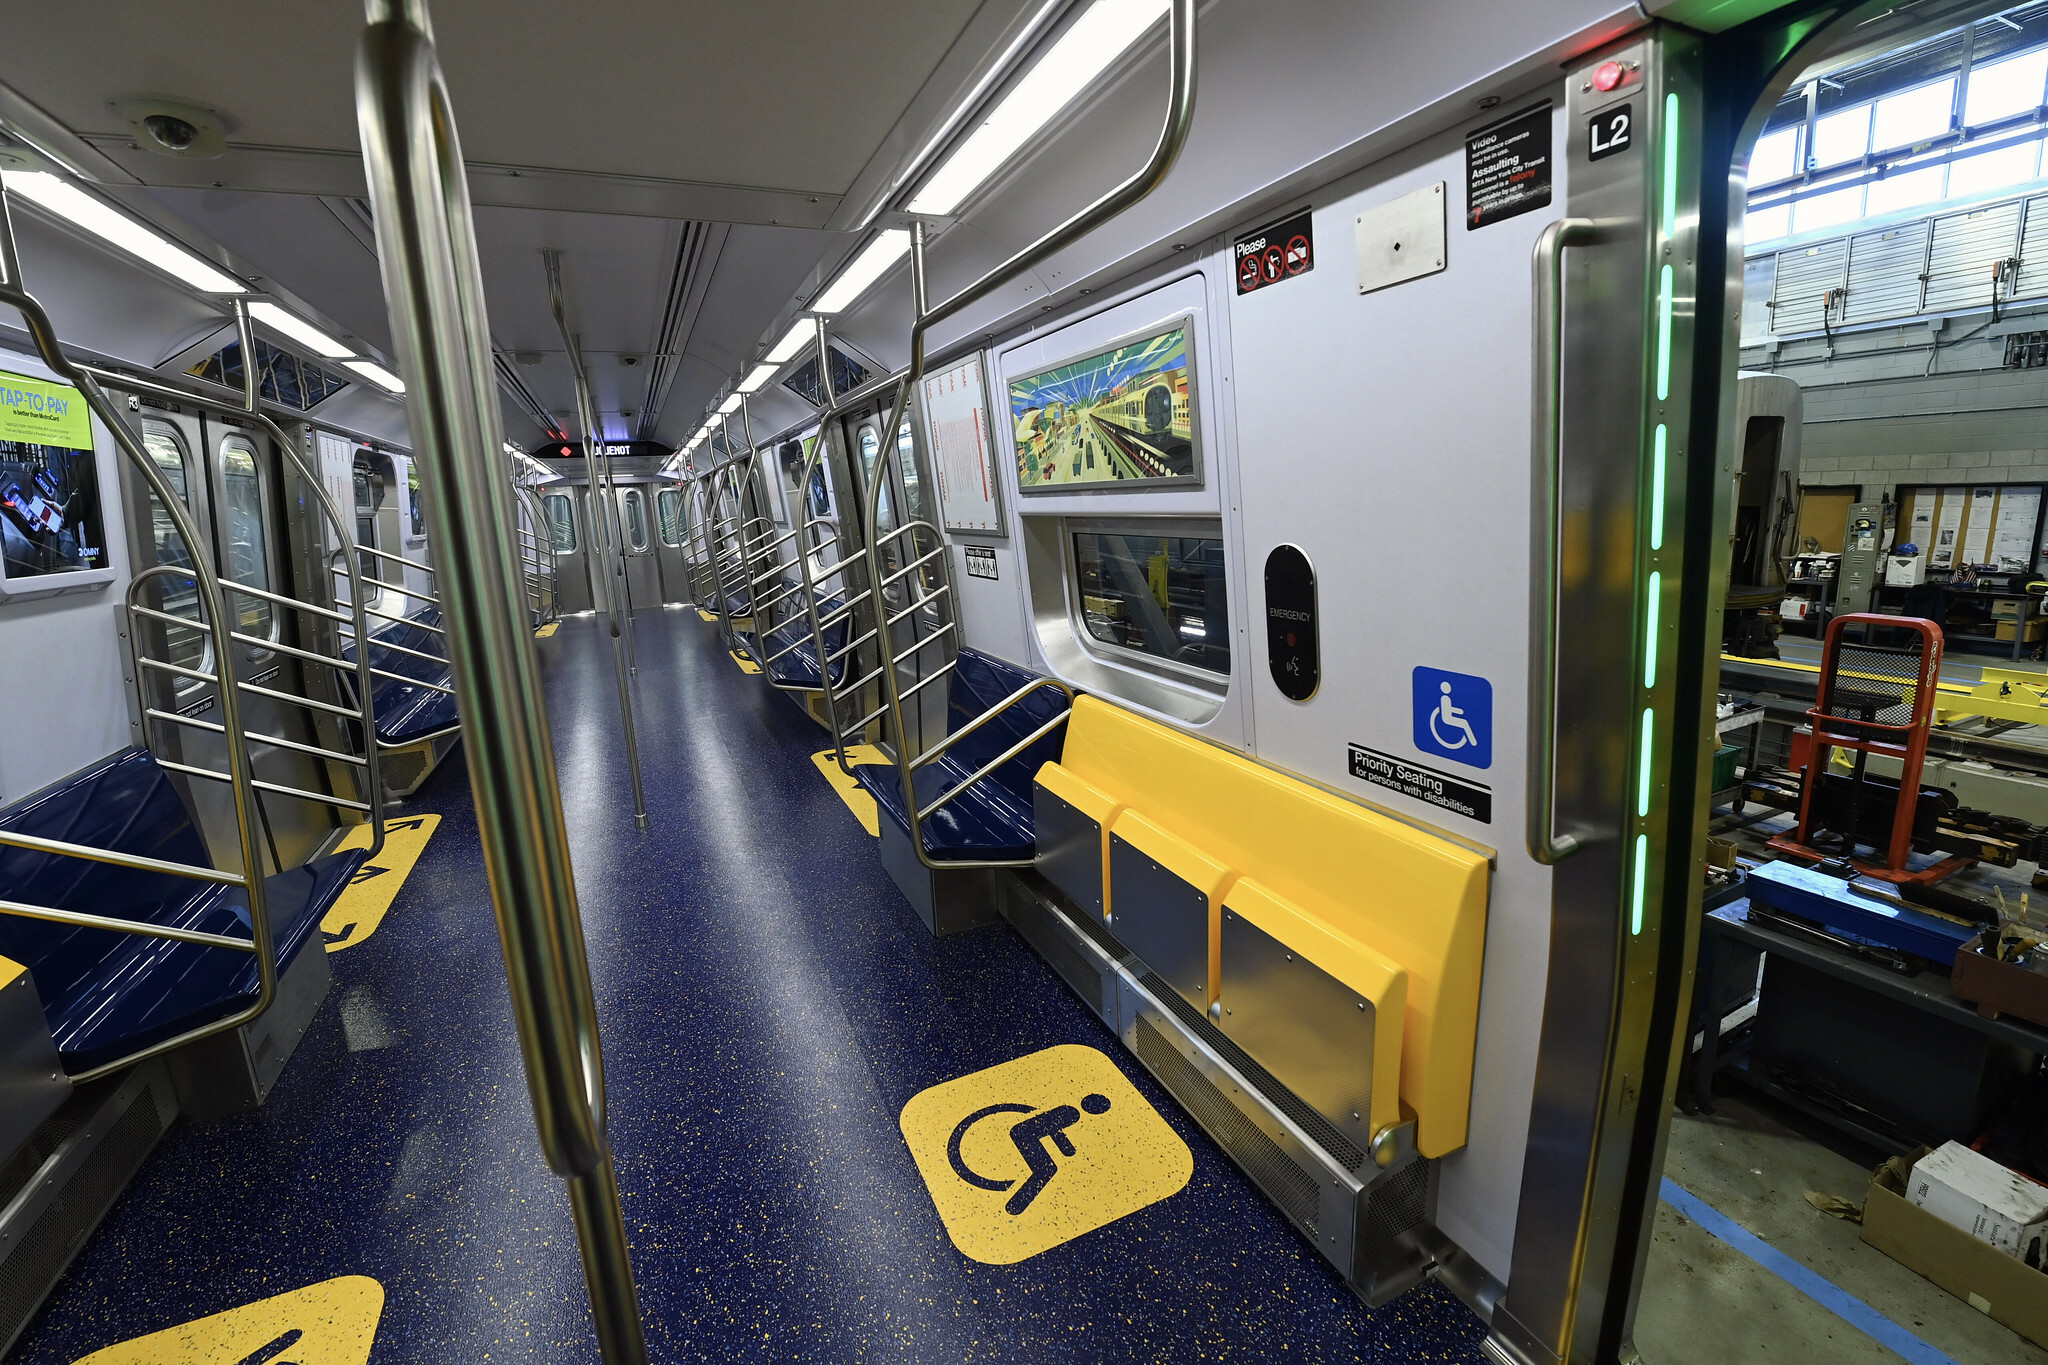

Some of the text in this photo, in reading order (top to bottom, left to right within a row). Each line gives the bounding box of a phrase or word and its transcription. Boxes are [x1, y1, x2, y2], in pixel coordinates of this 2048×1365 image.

[1472, 135, 1497, 150] Video
[1472, 131, 1530, 159] surveillance cameras
[1591, 114, 1629, 154] L2
[1472, 158, 1483, 167] may
[1472, 155, 1519, 179] Assaulting
[1472, 156, 1545, 189] MTA New York City Transit
[1472, 183, 1498, 198] personnel
[1509, 169, 1536, 183] felony
[1473, 206, 1482, 223] 7
[1237, 238, 1266, 258] Please
[0, 387, 68, 416] TAP-TO-PAY
[83, 547, 99, 556] OMNY
[1270, 608, 1311, 622] EMERGENCY
[204, 700, 212, 710] door
[1354, 751, 1443, 795] Priority Seating
[1355, 767, 1475, 816] for persons with disabilities
